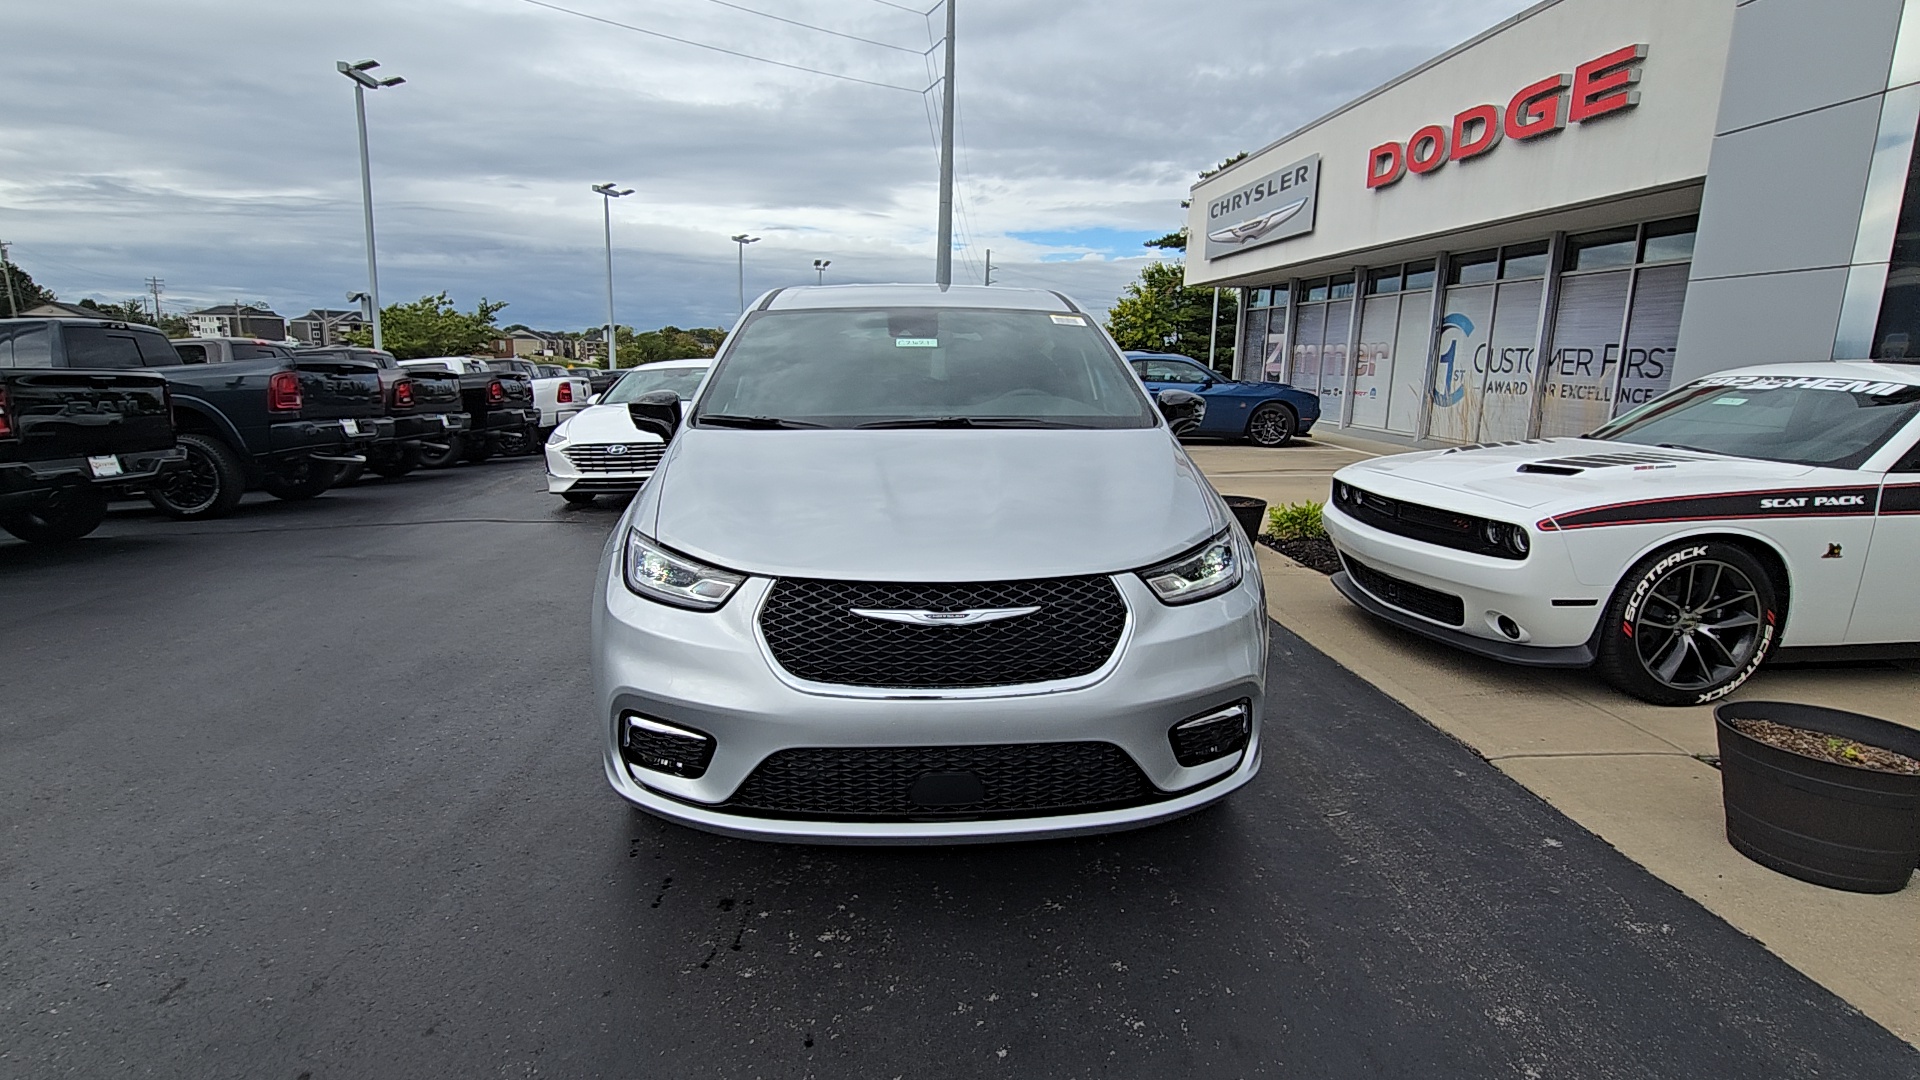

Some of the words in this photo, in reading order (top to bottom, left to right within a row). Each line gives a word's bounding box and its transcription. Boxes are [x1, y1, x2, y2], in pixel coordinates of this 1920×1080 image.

[1366, 43, 1648, 189] DODGE
[1210, 165, 1309, 219] CHRYSLER
[1265, 333, 1389, 376] Zmmer
[67, 400, 139, 415] RAM
[1486, 380, 1528, 396] AWARD
[1560, 383, 1655, 404] EXCELLNCE
[1783, 377, 1908, 396] HEMI
[1760, 497, 1809, 509] SCAT
[1814, 495, 1865, 507] PACK
[1624, 545, 1708, 622] SCATPACK
[1695, 624, 1774, 703] SCATPACK
